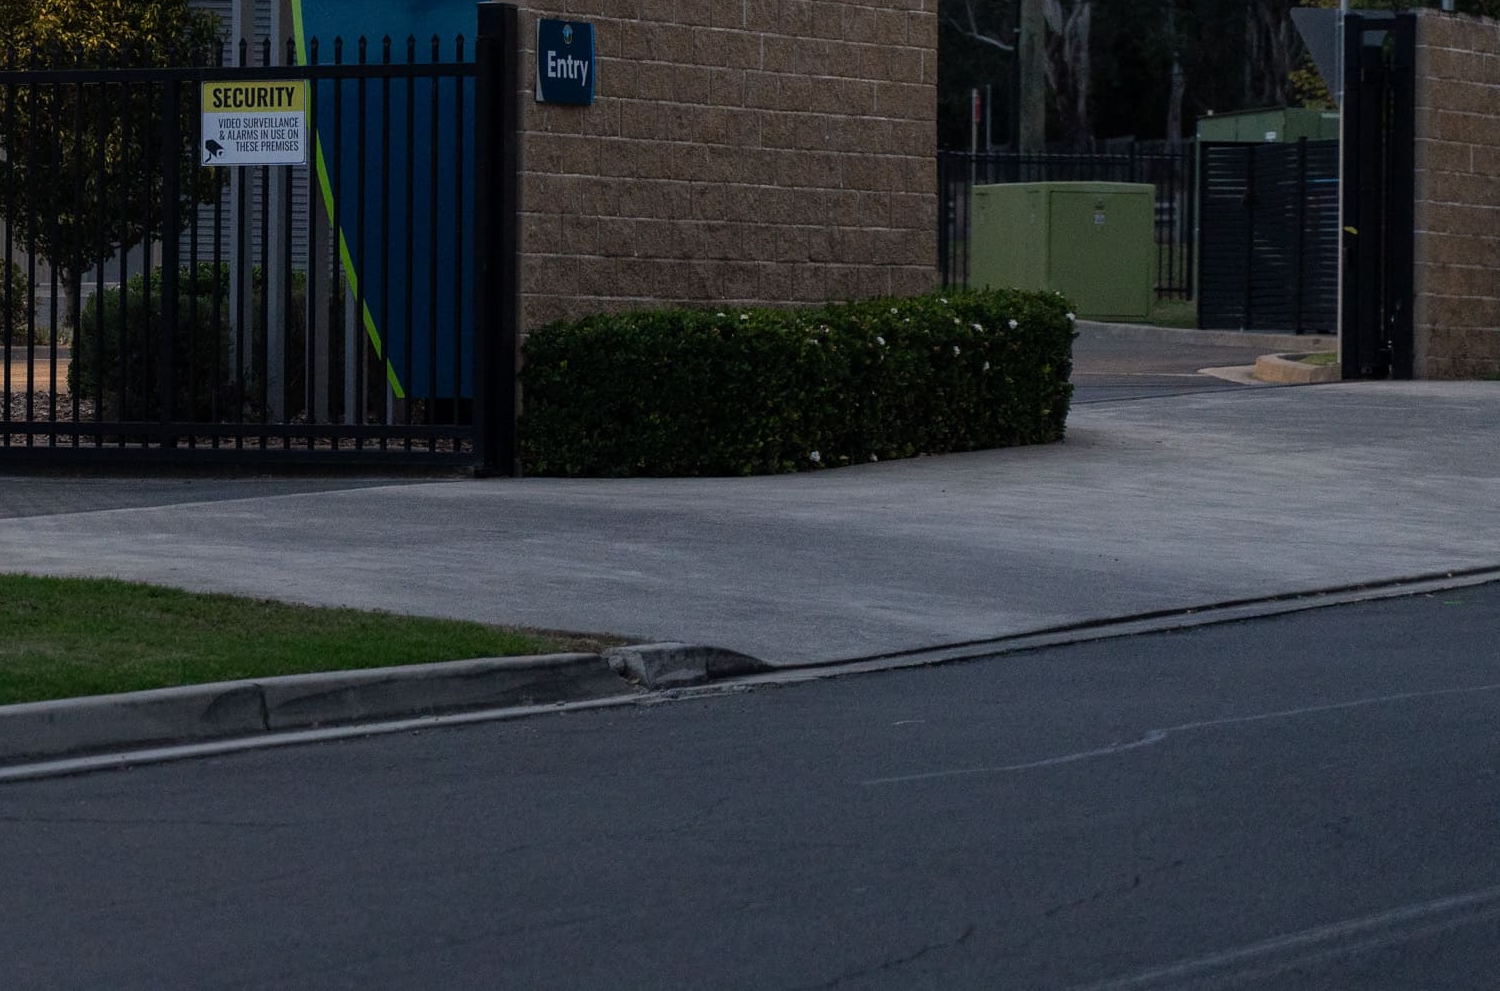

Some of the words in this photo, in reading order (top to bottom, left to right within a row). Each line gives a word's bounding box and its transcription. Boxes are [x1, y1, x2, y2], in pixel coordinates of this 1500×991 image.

[547, 50, 588, 87] Entry
[212, 87, 295, 108] SECURITY
[218, 118, 241, 129] VIDEO
[243, 117, 299, 129] SURVEILLANCE
[219, 130, 226, 141] &
[227, 130, 259, 141] ALARMS
[260, 130, 269, 140] IN
[270, 129, 286, 140] USE
[287, 129, 299, 140] ON
[235, 141, 259, 152] THESE
[260, 140, 299, 152] PREMISES
